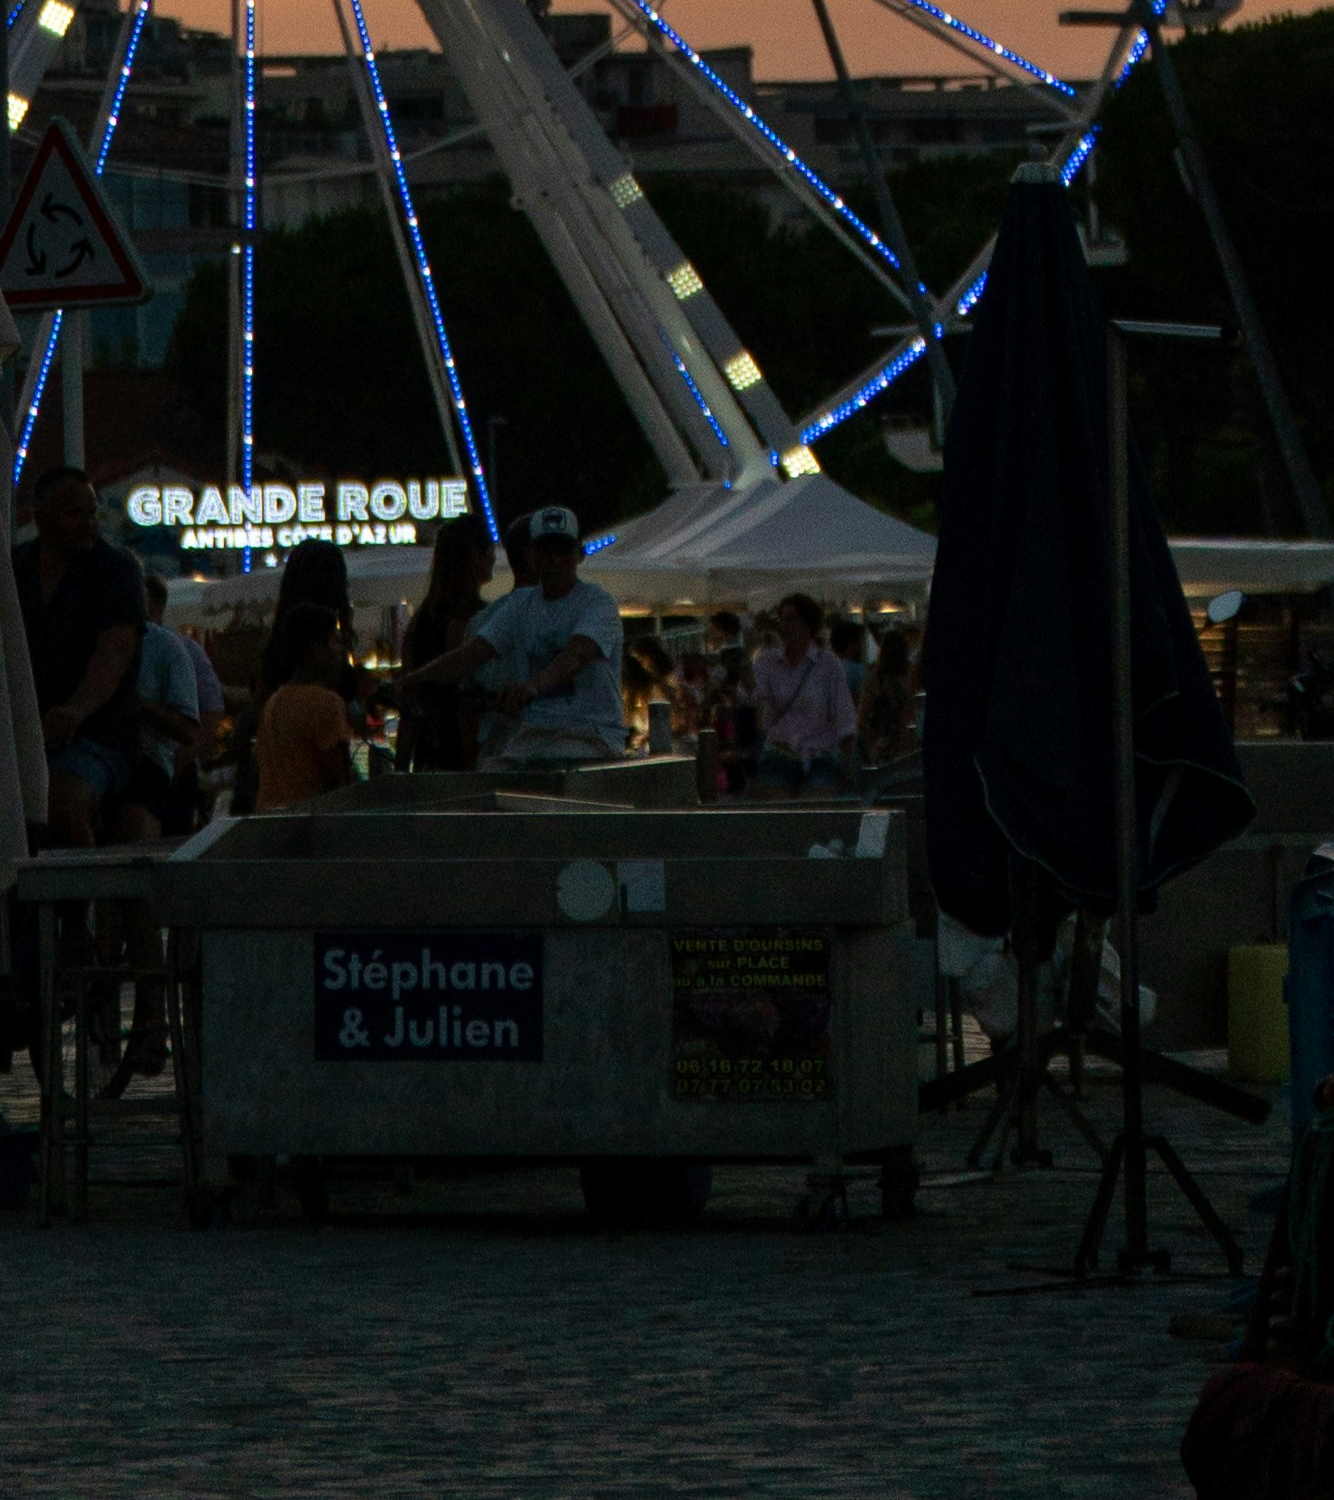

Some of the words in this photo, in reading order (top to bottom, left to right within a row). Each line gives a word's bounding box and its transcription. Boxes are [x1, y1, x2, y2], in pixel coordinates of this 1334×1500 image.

[127, 482, 326, 526] GRANDE
[337, 479, 469, 521] ROUE
[181, 526, 273, 549] ANTIBES
[673, 938, 728, 952] VENTE
[733, 938, 824, 952] D'OURSINS
[707, 959, 732, 970] sur
[736, 956, 790, 969] PLACE
[322, 947, 535, 1001] Stéphane
[729, 974, 827, 987] COMMANDE
[338, 1006, 372, 1048] &
[383, 1004, 520, 1048] Julien
[675, 1059, 701, 1074] 06
[708, 1059, 732, 1074] 16
[738, 1059, 763, 1073] 72
[770, 1059, 794, 1073] 18
[800, 1059, 825, 1073] 07
[800, 1079, 826, 1093] 02
